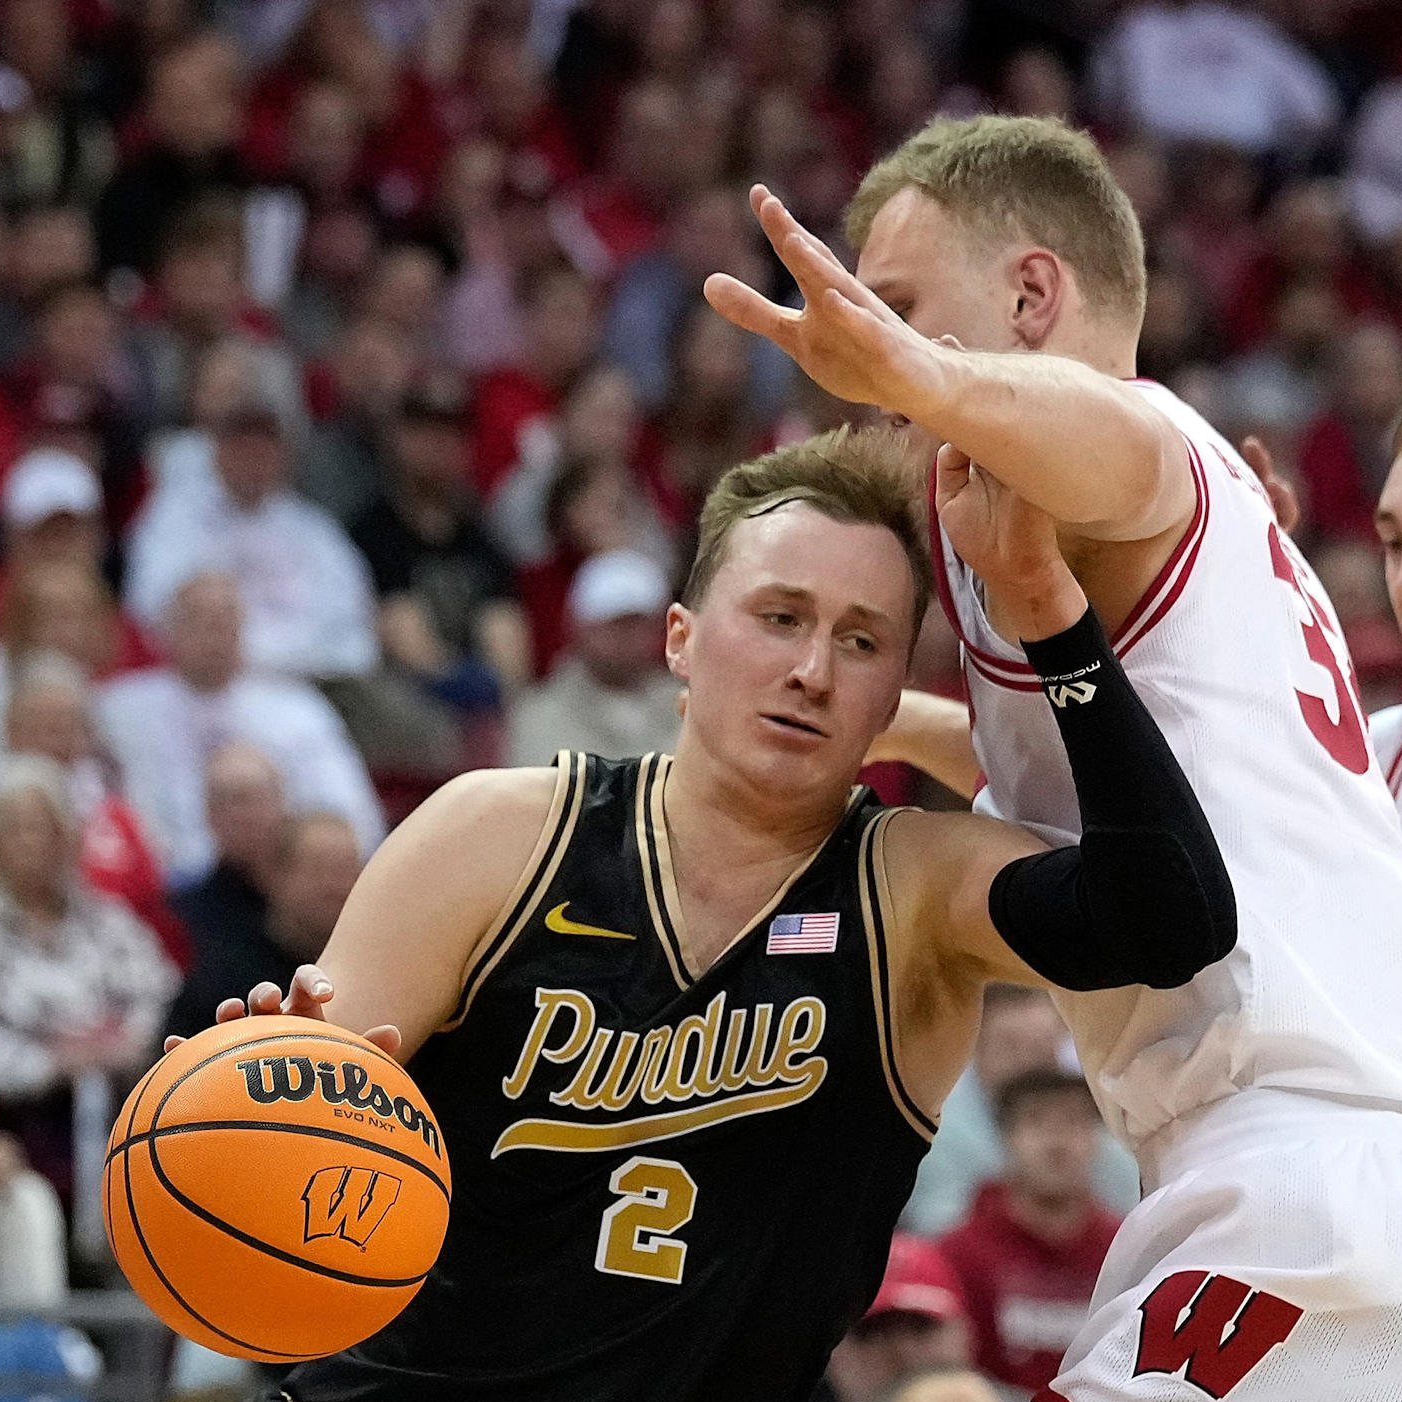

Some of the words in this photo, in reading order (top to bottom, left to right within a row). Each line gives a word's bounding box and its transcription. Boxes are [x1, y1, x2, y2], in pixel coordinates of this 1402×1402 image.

[502, 987, 827, 1112] Purdue
[236, 1055, 442, 1161] Wilson
[333, 1107, 365, 1123] EVO
[367, 1117, 397, 1134] NXT
[300, 1165, 403, 1248] W
[594, 1155, 699, 1285] 2
[1131, 1269, 1305, 1400] W
